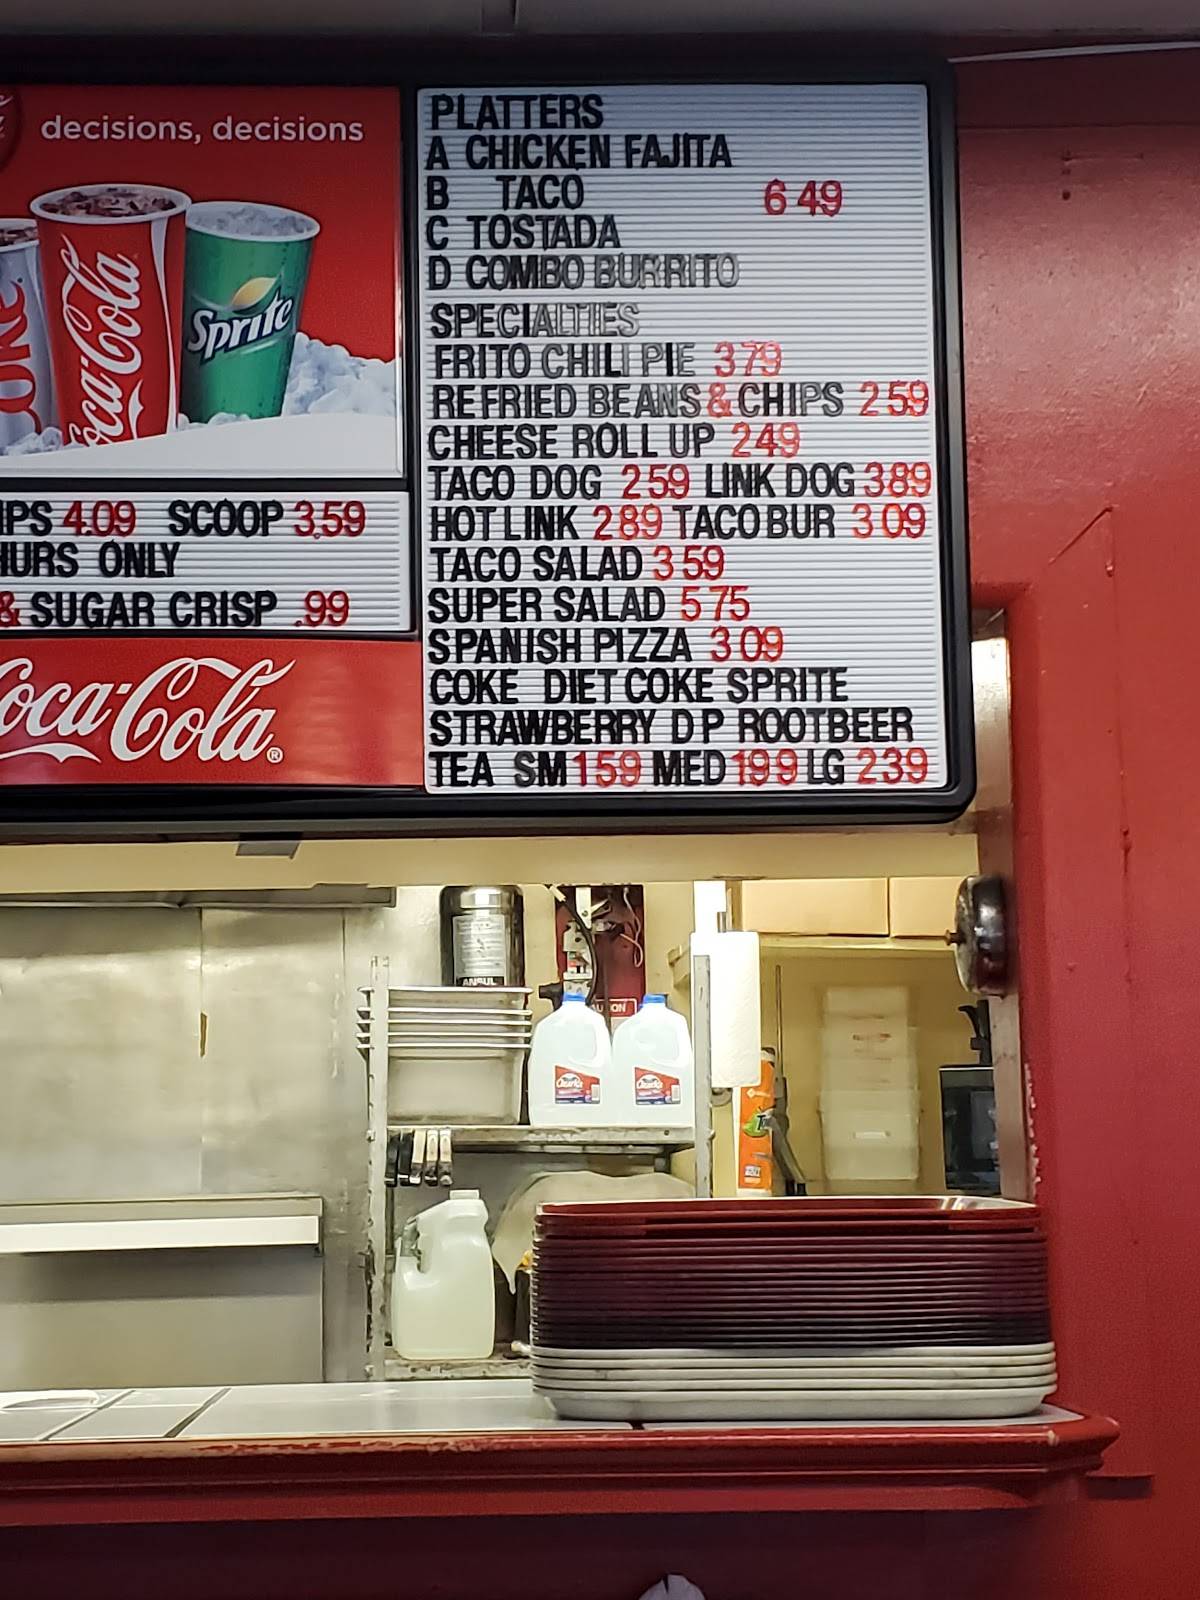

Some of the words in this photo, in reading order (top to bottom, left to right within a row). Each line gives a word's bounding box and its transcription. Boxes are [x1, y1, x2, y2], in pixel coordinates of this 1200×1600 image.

[41, 116, 201, 144] decisions,
[212, 116, 364, 141] decisions
[431, 94, 604, 129] PLATTERS
[425, 137, 450, 170] A
[466, 134, 610, 169] CHICKEN
[625, 134, 733, 168] FAJITA
[425, 175, 450, 210] B
[496, 173, 584, 210] TACO
[425, 215, 449, 250] C
[472, 214, 621, 250] TOSTADA
[428, 255, 451, 290] D
[466, 254, 585, 290] COMBO
[595, 253, 740, 289] BURRITO
[187, 288, 293, 361] Sprite
[431, 302, 641, 338] SPECIALTIES
[435, 343, 531, 379] FRITO
[542, 343, 630, 378] CHILI
[643, 342, 696, 377] PIE
[433, 384, 577, 419] REFRIED
[588, 383, 701, 418] BEANS
[738, 381, 844, 417] CHIPS
[428, 424, 558, 460] CHEESE
[572, 423, 658, 459] ROLL
[669, 423, 715, 458] UP
[427, 465, 515, 500] TACO
[530, 465, 601, 500] DOG
[705, 463, 776, 498] LINK
[786, 463, 854, 498] DOG
[168, 499, 284, 537] SCOOP
[293, 500, 366, 539] 3.59
[431, 506, 495, 542] HOT
[503, 505, 580, 541] LINK
[672, 503, 760, 540] TACO
[768, 503, 835, 539] BUR
[99, 540, 181, 577] ONLY
[429, 546, 521, 582] TACO
[533, 546, 642, 582] SALAD
[0, 591, 20, 627] &
[30, 591, 155, 628] SUGAR
[169, 590, 277, 627] CRISP
[294, 590, 350, 627] .99
[428, 586, 542, 623] SUPER
[553, 586, 666, 622] SALAD
[428, 626, 581, 664] SPANISH
[594, 627, 692, 663] PIZZA
[429, 669, 517, 704] COKE
[544, 669, 617, 703] DIET
[624, 668, 714, 703] COKE
[727, 667, 848, 702] SPRITE
[429, 707, 656, 746] STRAWBERRY
[739, 706, 913, 743] ROOTBEER
[429, 751, 494, 787] TEA
[514, 750, 568, 787] SM
[653, 750, 726, 785] MED
[806, 748, 845, 785] LG
